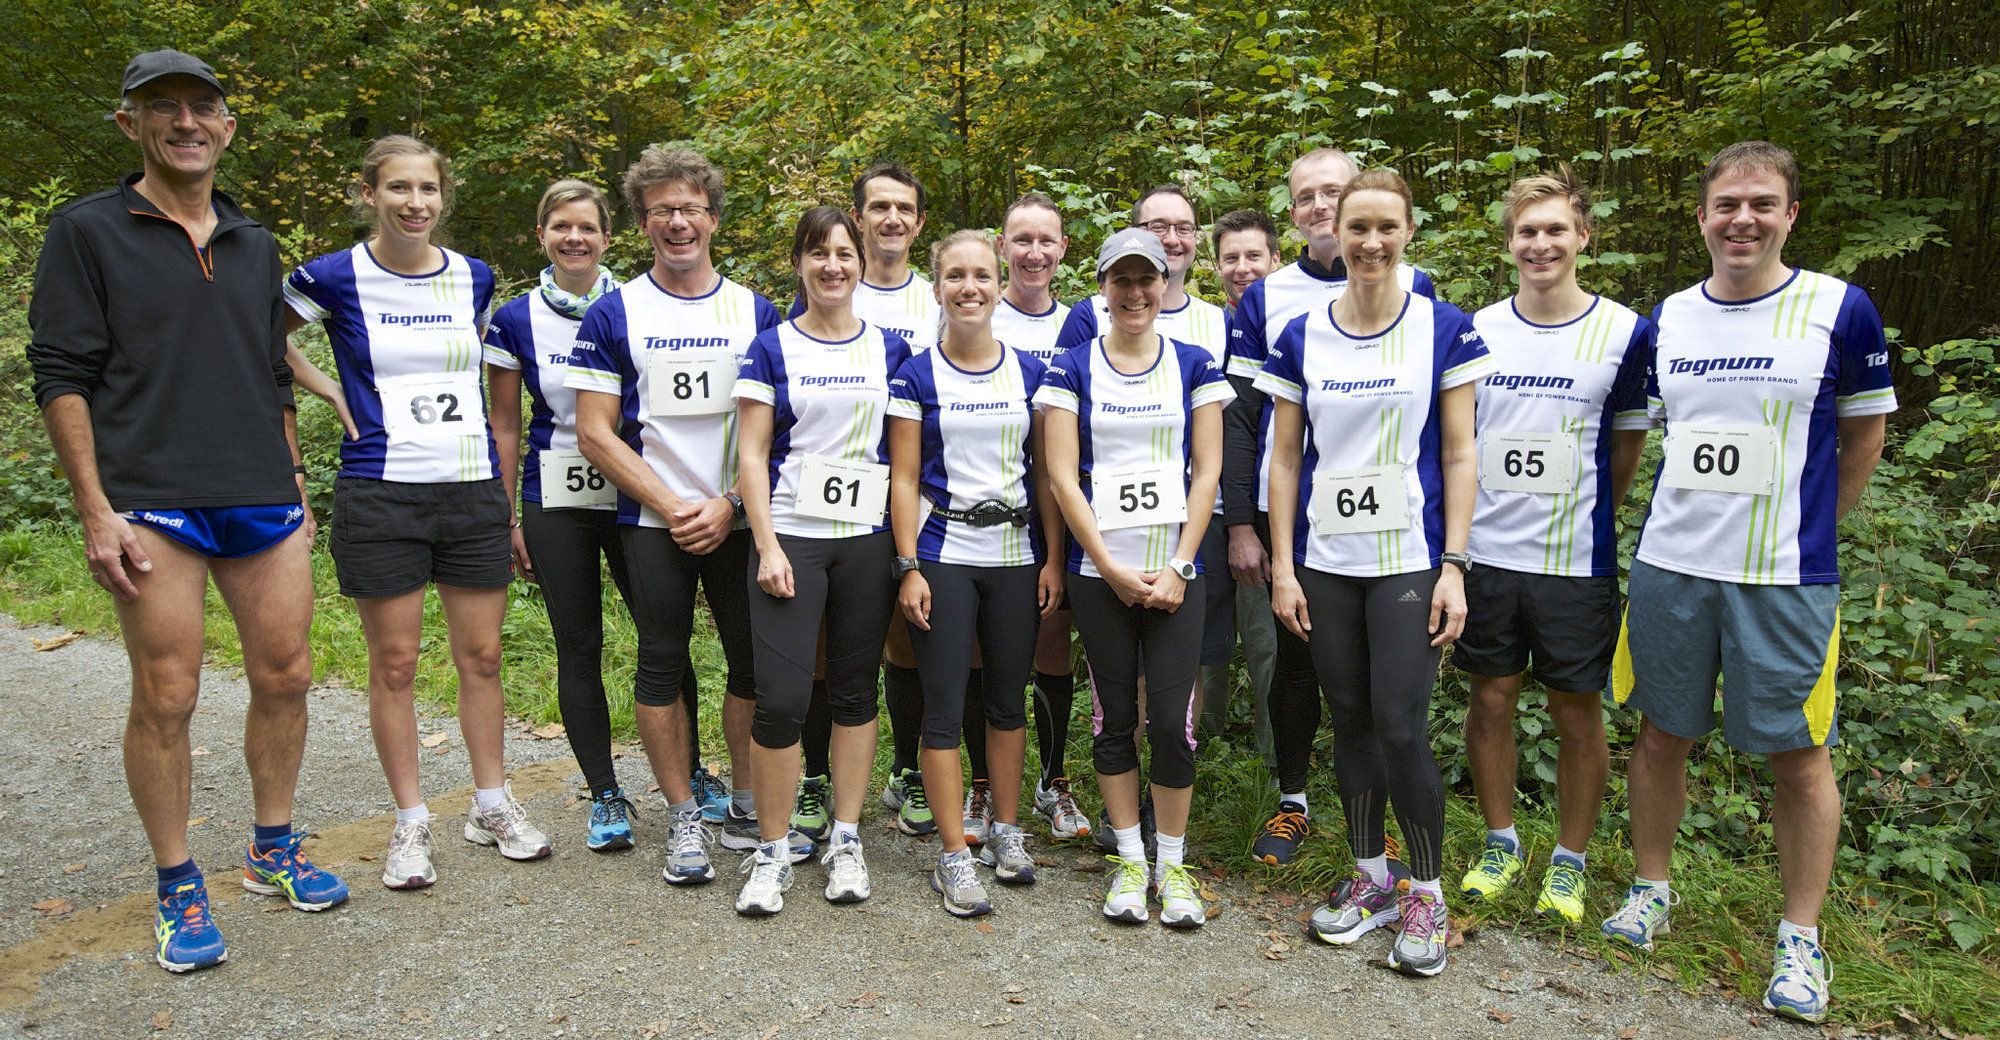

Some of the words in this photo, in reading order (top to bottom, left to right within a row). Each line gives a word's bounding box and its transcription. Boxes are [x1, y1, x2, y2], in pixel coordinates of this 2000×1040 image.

[378, 313, 452, 326] Tognum
[643, 336, 730, 351] Tognum
[1669, 357, 1774, 376] Tognum
[673, 371, 710, 400] 81
[799, 375, 866, 387] Tognum
[1322, 378, 1396, 394] Tognum
[1767, 377, 1798, 385] BRANDS
[950, 401, 1009, 413] Tognum
[1101, 402, 1161, 415] Tognum
[1567, 395, 1591, 404] BRANDS
[410, 393, 463, 425] 62
[1504, 450, 1545, 478] 65
[1693, 443, 1740, 476] 60
[566, 465, 605, 492] 58
[823, 476, 861, 507] 61
[1119, 481, 1159, 513] 55
[1336, 486, 1379, 517] 64
[143, 511, 184, 529] bredl
